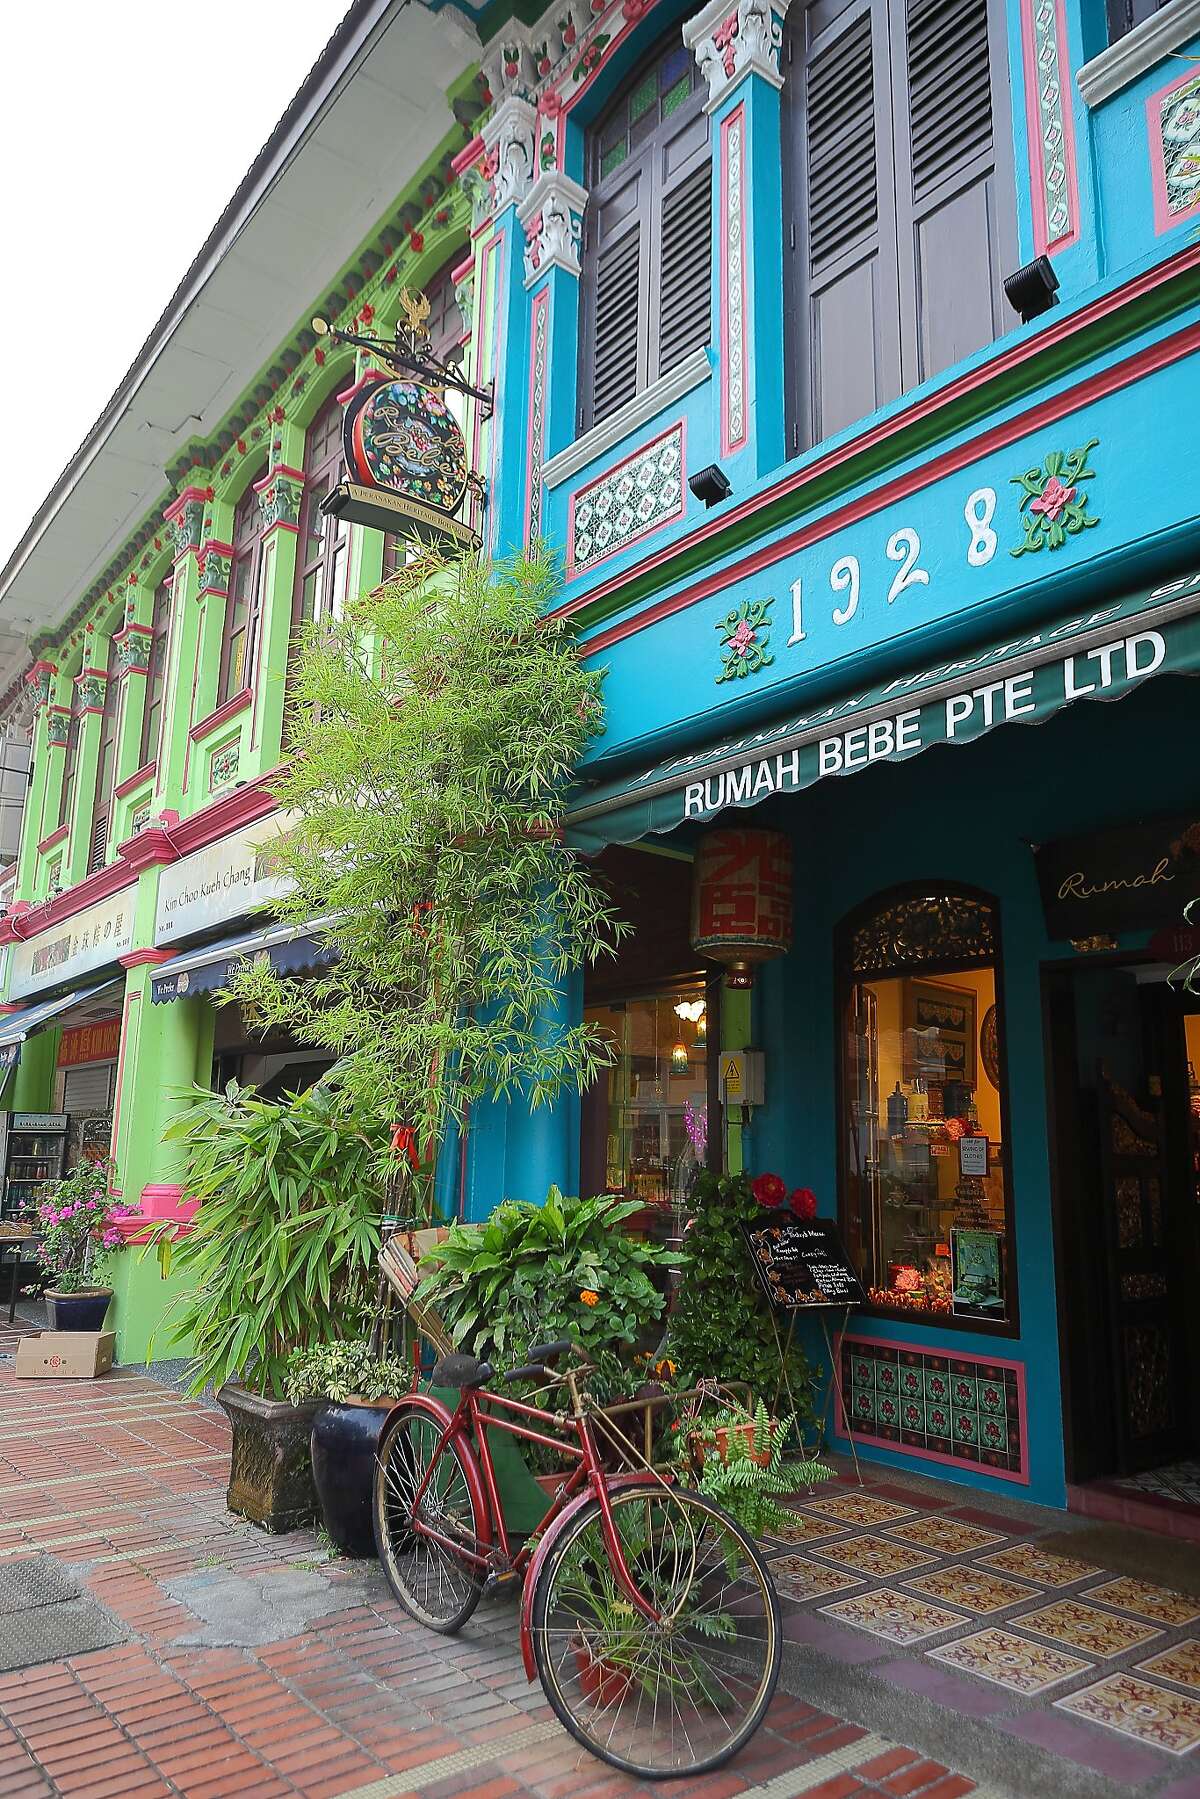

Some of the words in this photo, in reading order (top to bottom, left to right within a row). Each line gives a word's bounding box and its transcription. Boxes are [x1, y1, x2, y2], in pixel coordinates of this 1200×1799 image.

[373, 406, 465, 452] Rumah
[371, 431, 458, 477] Bebe
[787, 487, 998, 647] 1928
[664, 692, 871, 773] PERANAKAN
[881, 603, 1123, 694] HERITAGE
[684, 749, 799, 817] RUMAH
[818, 708, 922, 777] BEBE
[945, 670, 1036, 738] PTE
[1063, 630, 1167, 700] LTD
[164, 898, 178, 913] Kim
[178, 890, 199, 907] Choo
[200, 871, 222, 896] Kueh
[223, 865, 251, 889] Chang
[1058, 857, 1176, 900] Rumah
